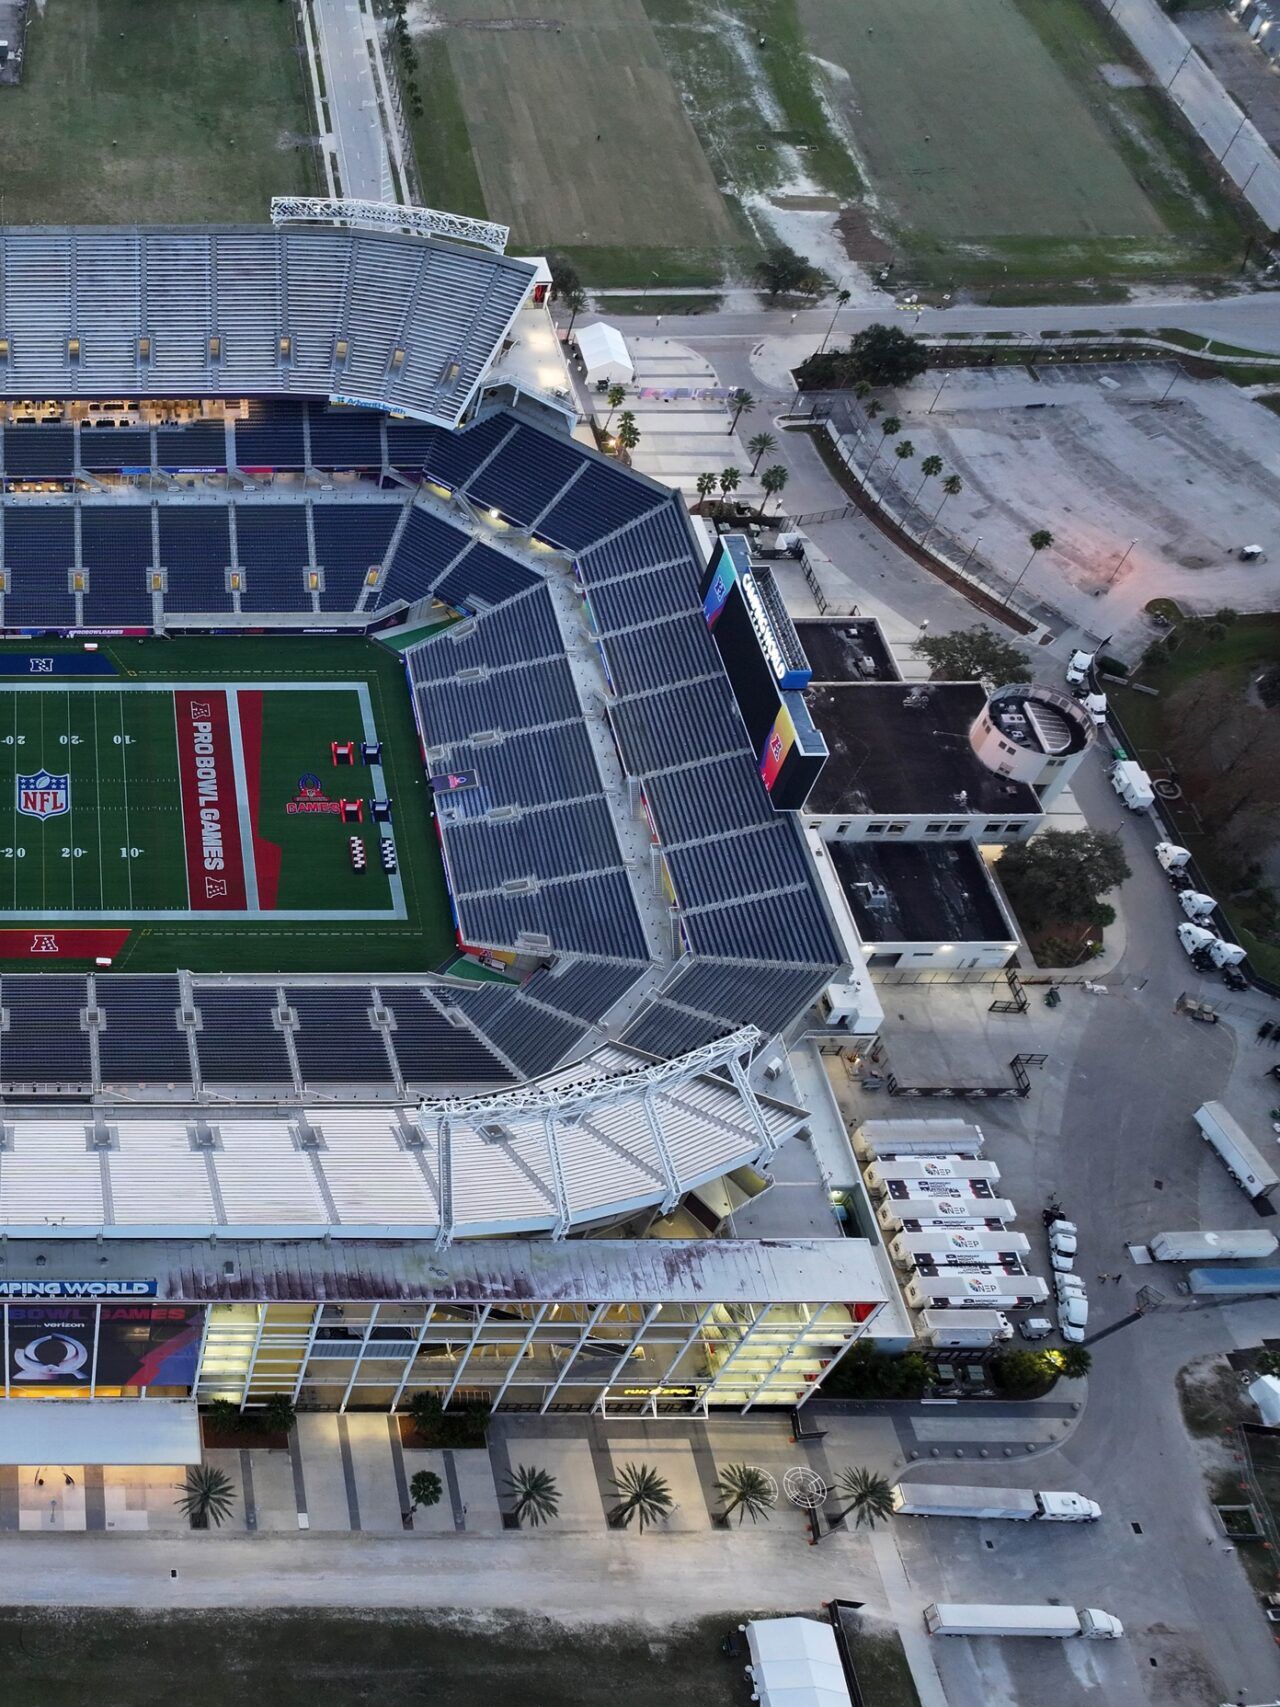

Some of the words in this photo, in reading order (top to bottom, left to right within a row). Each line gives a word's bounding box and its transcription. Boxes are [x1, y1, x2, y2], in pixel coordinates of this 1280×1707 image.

[347, 398, 406, 415] AdventHealth
[742, 573, 768, 634] CAMPING
[763, 626, 786, 680] WORLD
[192, 722, 214, 755] PRO
[195, 756, 218, 807] BOWL
[23, 791, 64, 813] NFL
[286, 803, 341, 815] GAMES
[200, 808, 225, 871] GAMES
[4, 847, 26, 858] 20
[61, 847, 83, 858] 20
[120, 847, 139, 858] 10
[62, 1282, 150, 1294] WORLD
[8, 1308, 91, 1320] BOWL
[92, 1308, 186, 1320] GAMES
